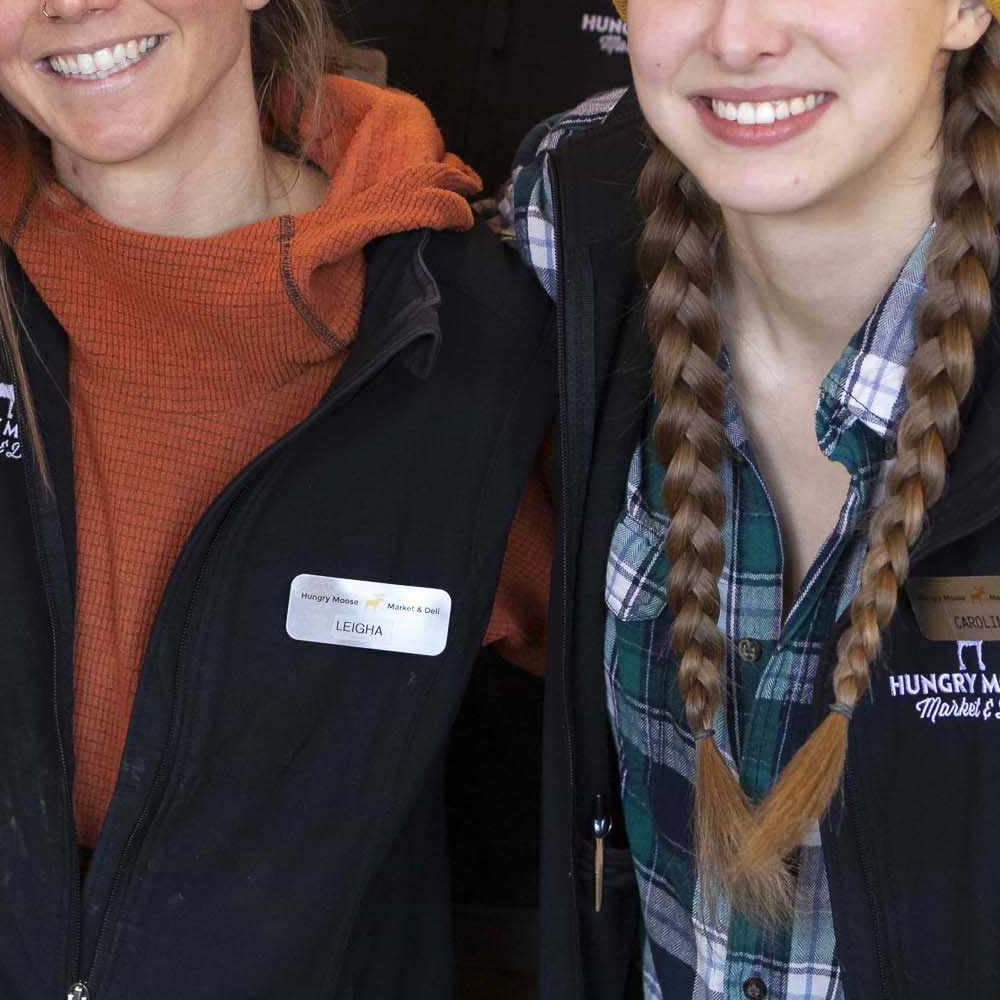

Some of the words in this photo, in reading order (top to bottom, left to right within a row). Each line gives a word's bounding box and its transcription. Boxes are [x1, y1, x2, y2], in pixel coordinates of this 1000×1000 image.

[301, 592, 330, 604] Hungry
[332, 596, 359, 606] Moose
[387, 602, 415, 613] Market
[424, 607, 440, 615] Deli
[335, 620, 383, 637] LEIGHA
[889, 672, 977, 696] HUNGRY
[981, 672, 1000, 694] M
[916, 696, 981, 723] Market
[982, 697, 995, 721] &
